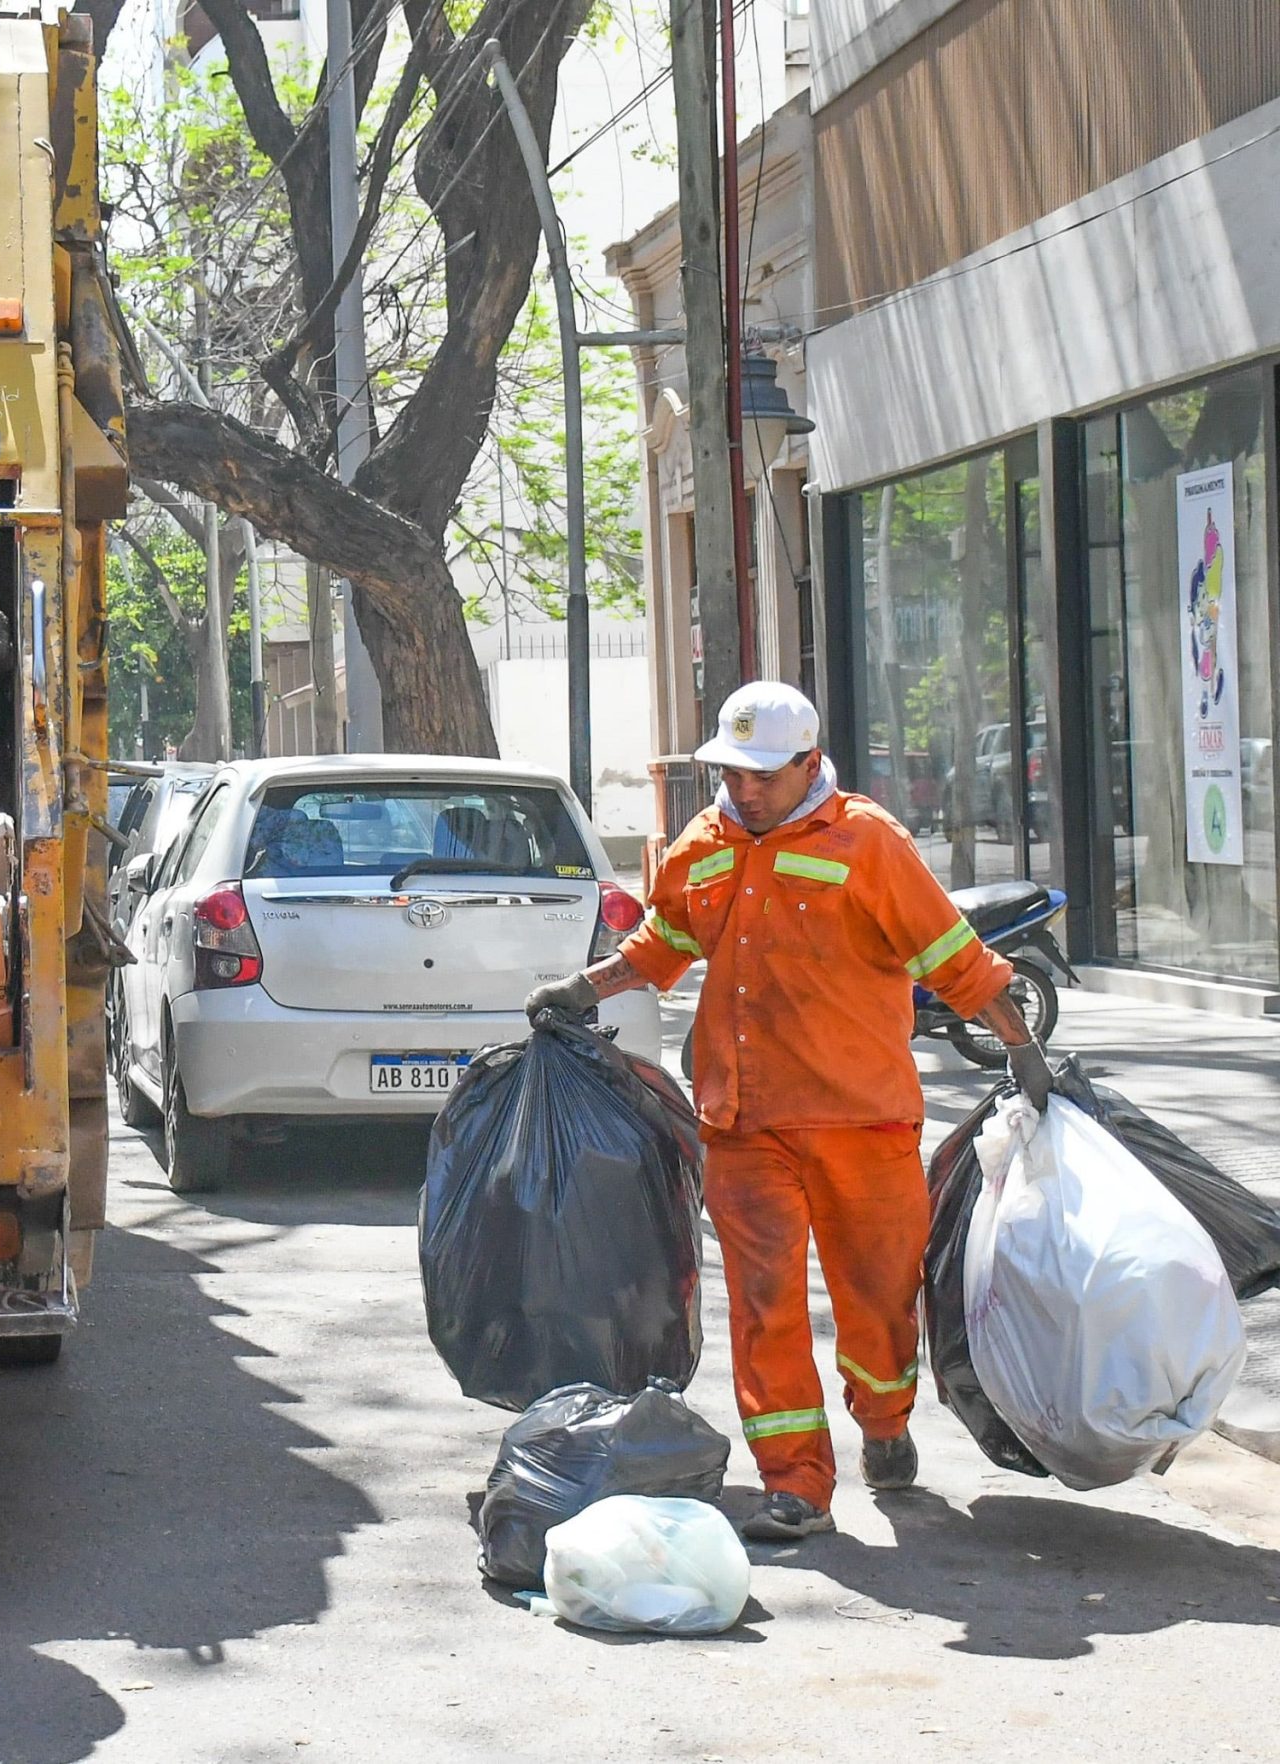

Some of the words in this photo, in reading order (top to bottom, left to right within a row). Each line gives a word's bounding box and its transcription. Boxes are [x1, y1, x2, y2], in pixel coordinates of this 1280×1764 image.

[262, 911, 301, 920] TOYOTA
[377, 1066, 403, 1089] AB
[410, 1066, 450, 1089] 810
